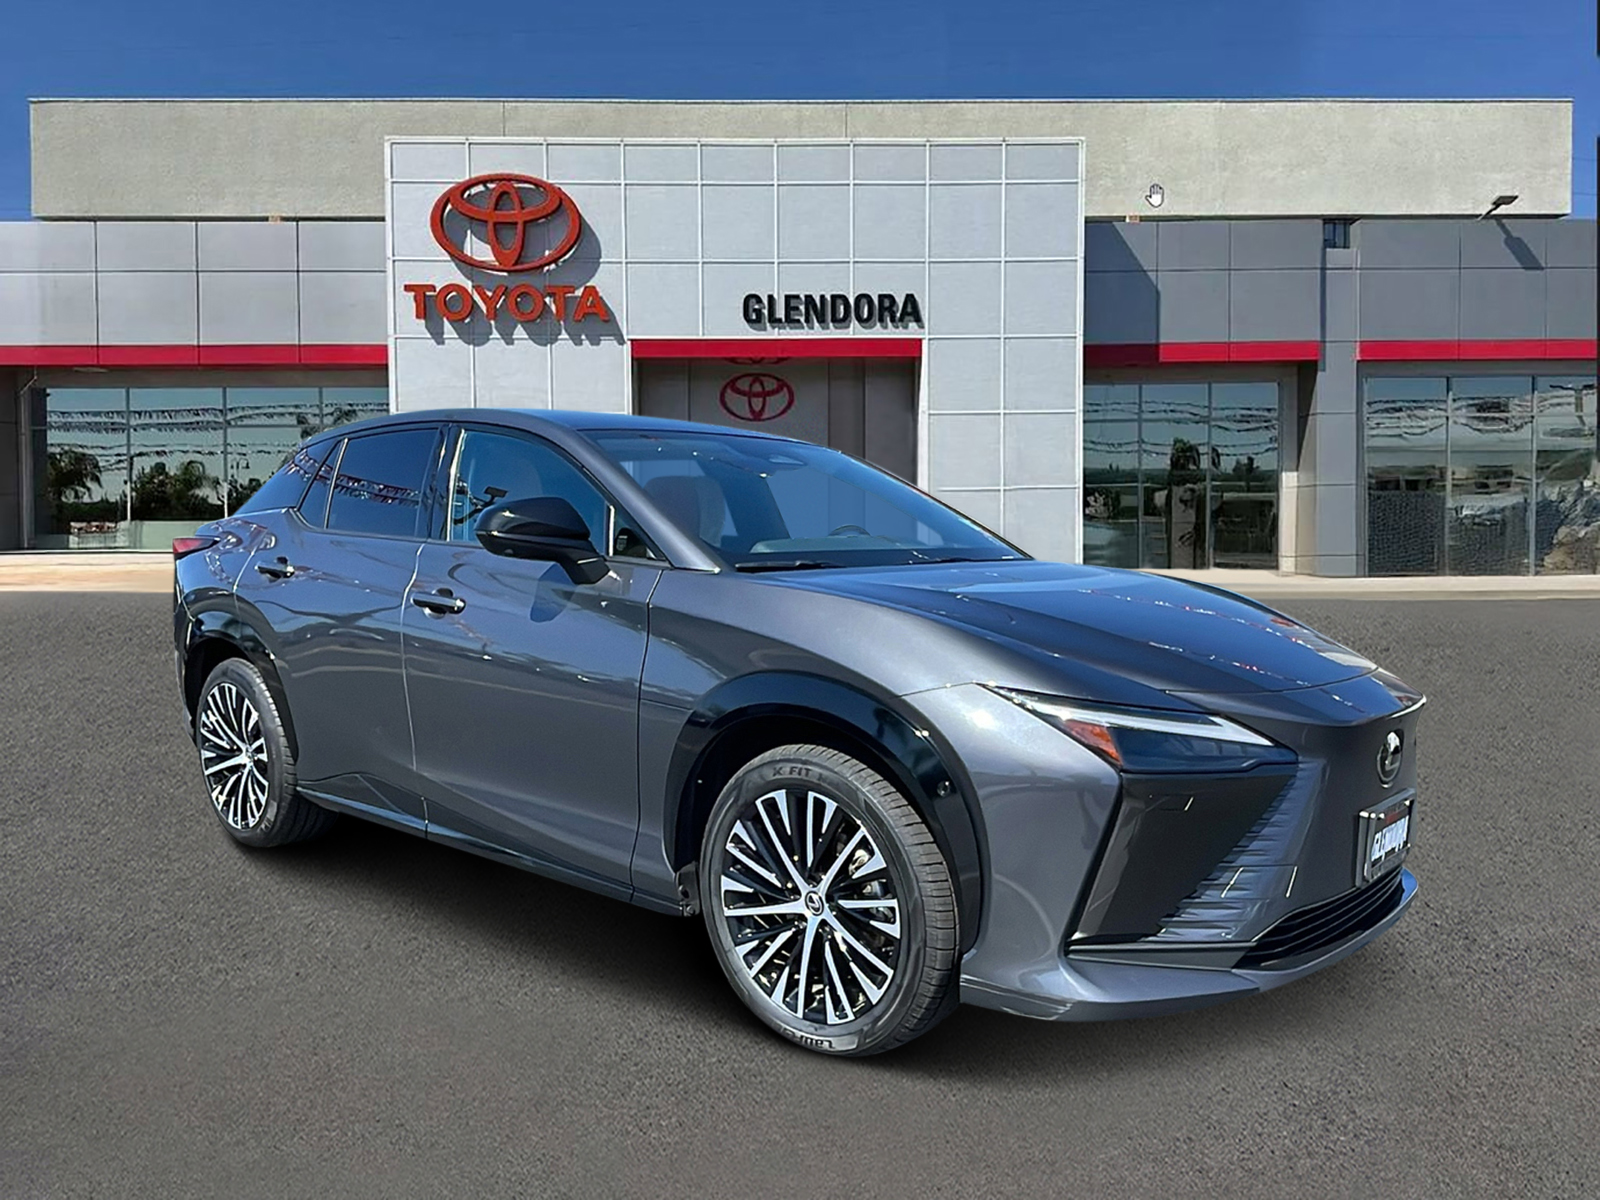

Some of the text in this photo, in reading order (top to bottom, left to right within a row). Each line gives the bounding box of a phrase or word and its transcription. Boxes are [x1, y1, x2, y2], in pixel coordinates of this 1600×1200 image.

[404, 283, 610, 322] TOYOTA
[743, 293, 922, 325] GLENDORA
[788, 765, 813, 777] FIT
